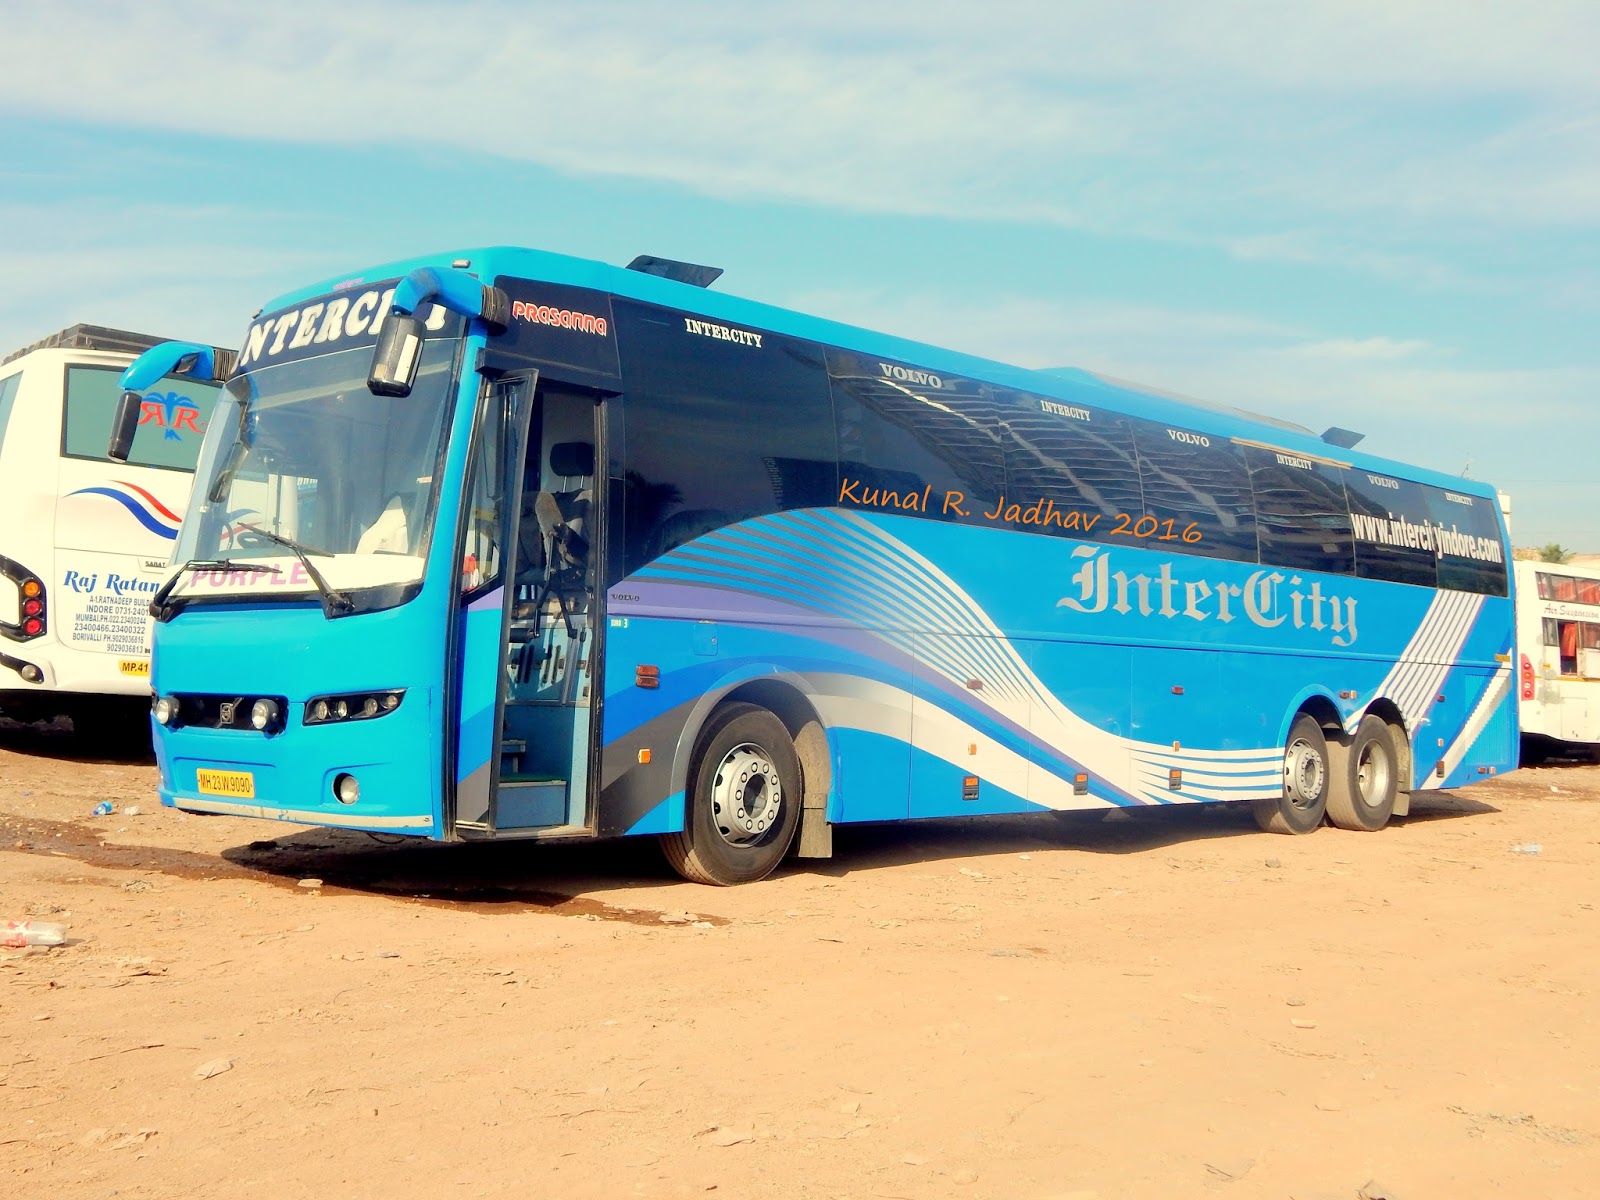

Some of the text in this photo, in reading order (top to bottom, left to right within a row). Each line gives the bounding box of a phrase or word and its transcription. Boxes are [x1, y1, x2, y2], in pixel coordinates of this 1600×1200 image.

[684, 318, 762, 348] INTERCITY
[879, 362, 942, 389] VOLVO
[1040, 400, 1091, 421] INTERCITY
[1167, 429, 1210, 447] VOLVO
[1275, 454, 1312, 470] INTERCITY
[1367, 474, 1399, 490] VOLVO
[1351, 512, 1502, 563] www.intercityindore.com
[63, 570, 160, 595] Raj Ratan
[611, 593, 640, 602] VOLVO
[1056, 545, 1358, 647] InterCity
[86, 605, 113, 613] INDORE
[122, 662, 149, 673] MP.41
